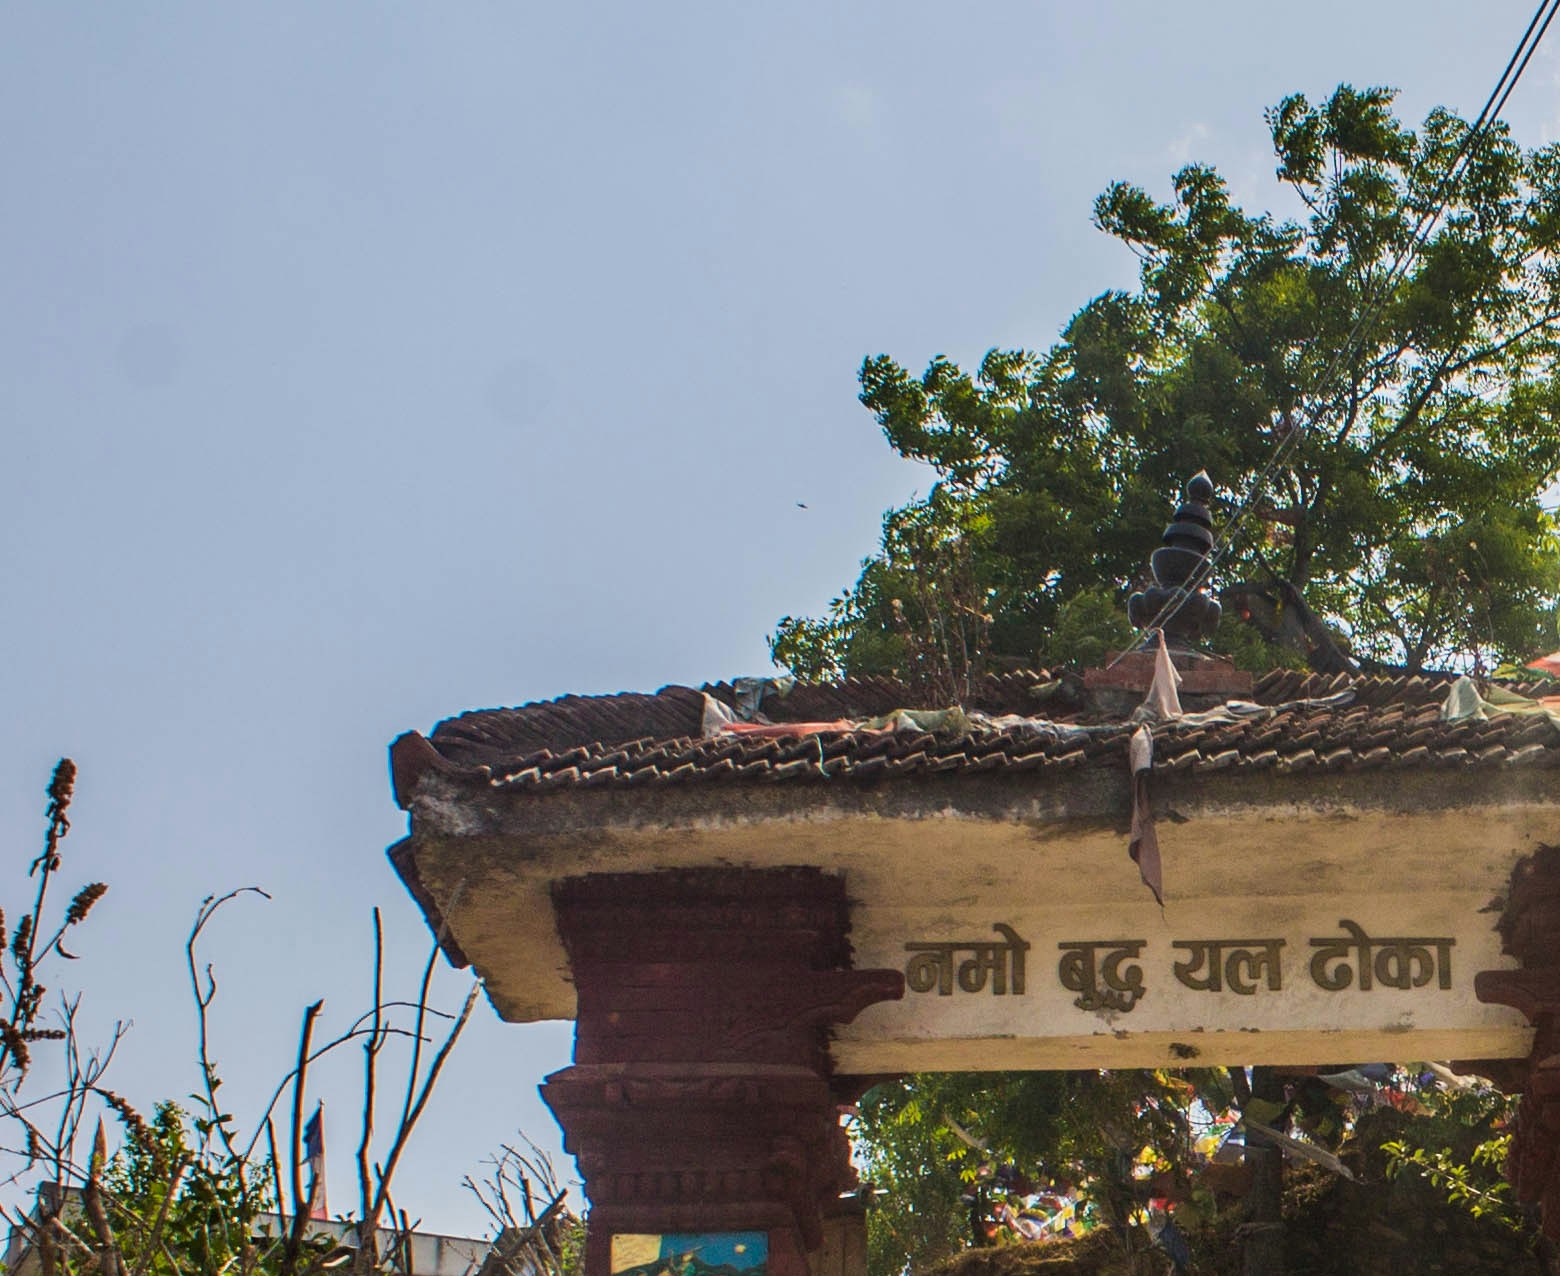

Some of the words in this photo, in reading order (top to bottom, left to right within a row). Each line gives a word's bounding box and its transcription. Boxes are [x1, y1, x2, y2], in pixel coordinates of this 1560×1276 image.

[905, 923, 1030, 996] नमो
[1172, 938, 1286, 993] यल
[1308, 919, 1456, 992] ढोका
